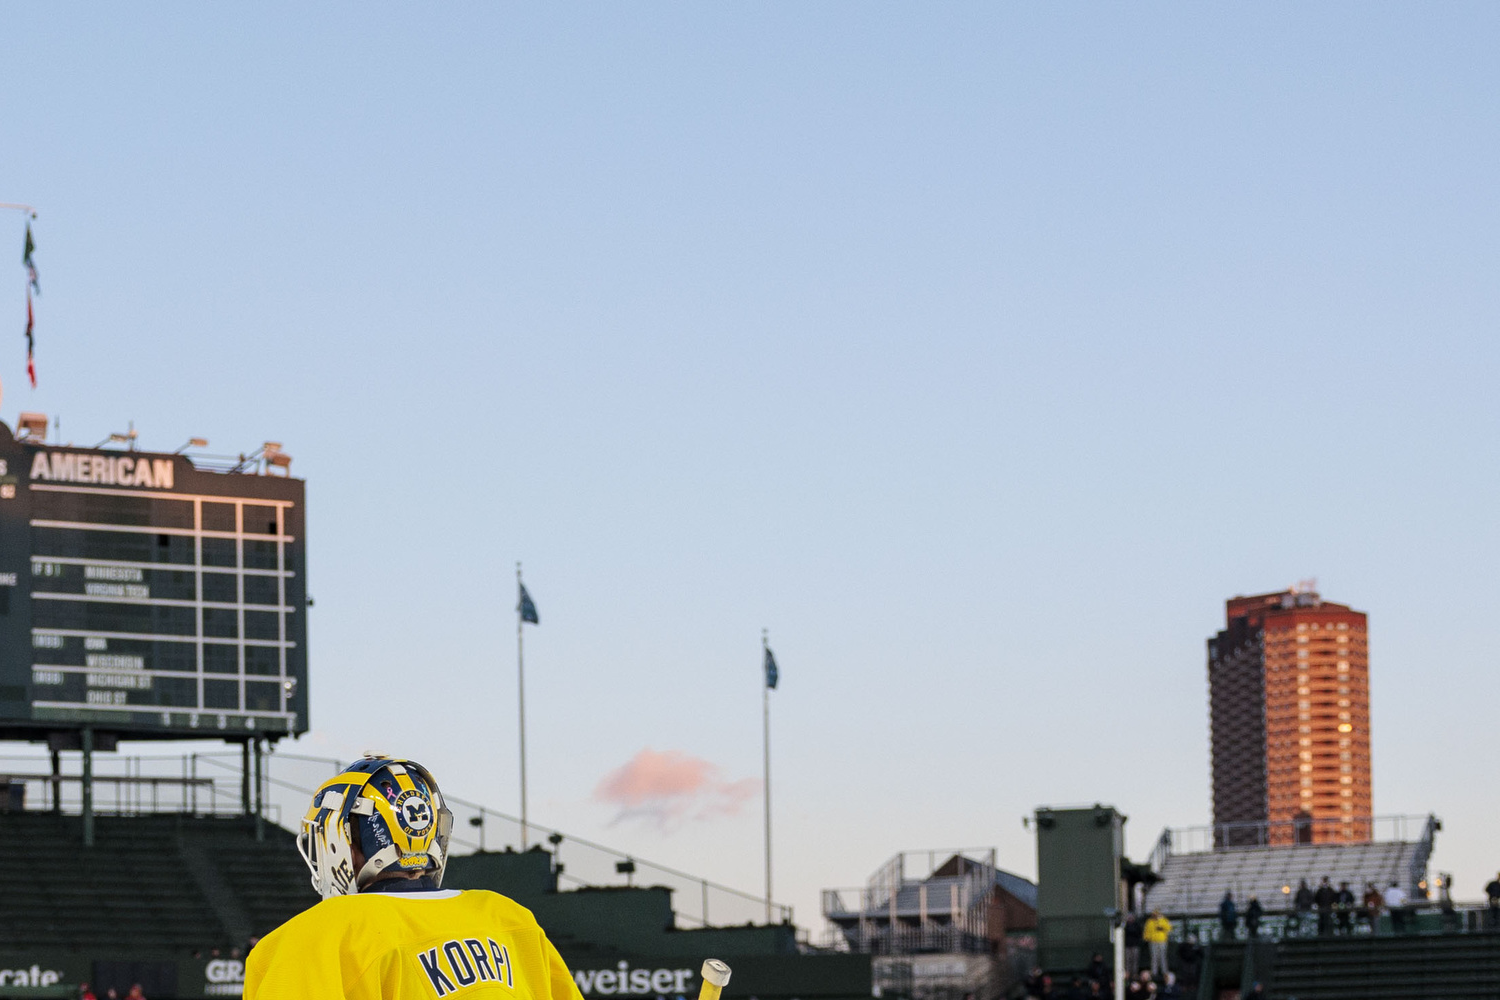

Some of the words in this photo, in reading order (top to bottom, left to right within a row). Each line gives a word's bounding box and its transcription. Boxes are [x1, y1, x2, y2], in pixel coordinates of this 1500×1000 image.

[30, 451, 174, 489] AMERICAN
[84, 565, 143, 582] MINNESOTA
[85, 653, 144, 669] WISCONSIN
[86, 672, 136, 688] MICHIGAN
[405, 803, 429, 823] M
[329, 858, 355, 896] LUE
[205, 959, 246, 983] GR
[416, 936, 514, 998] KORPI
